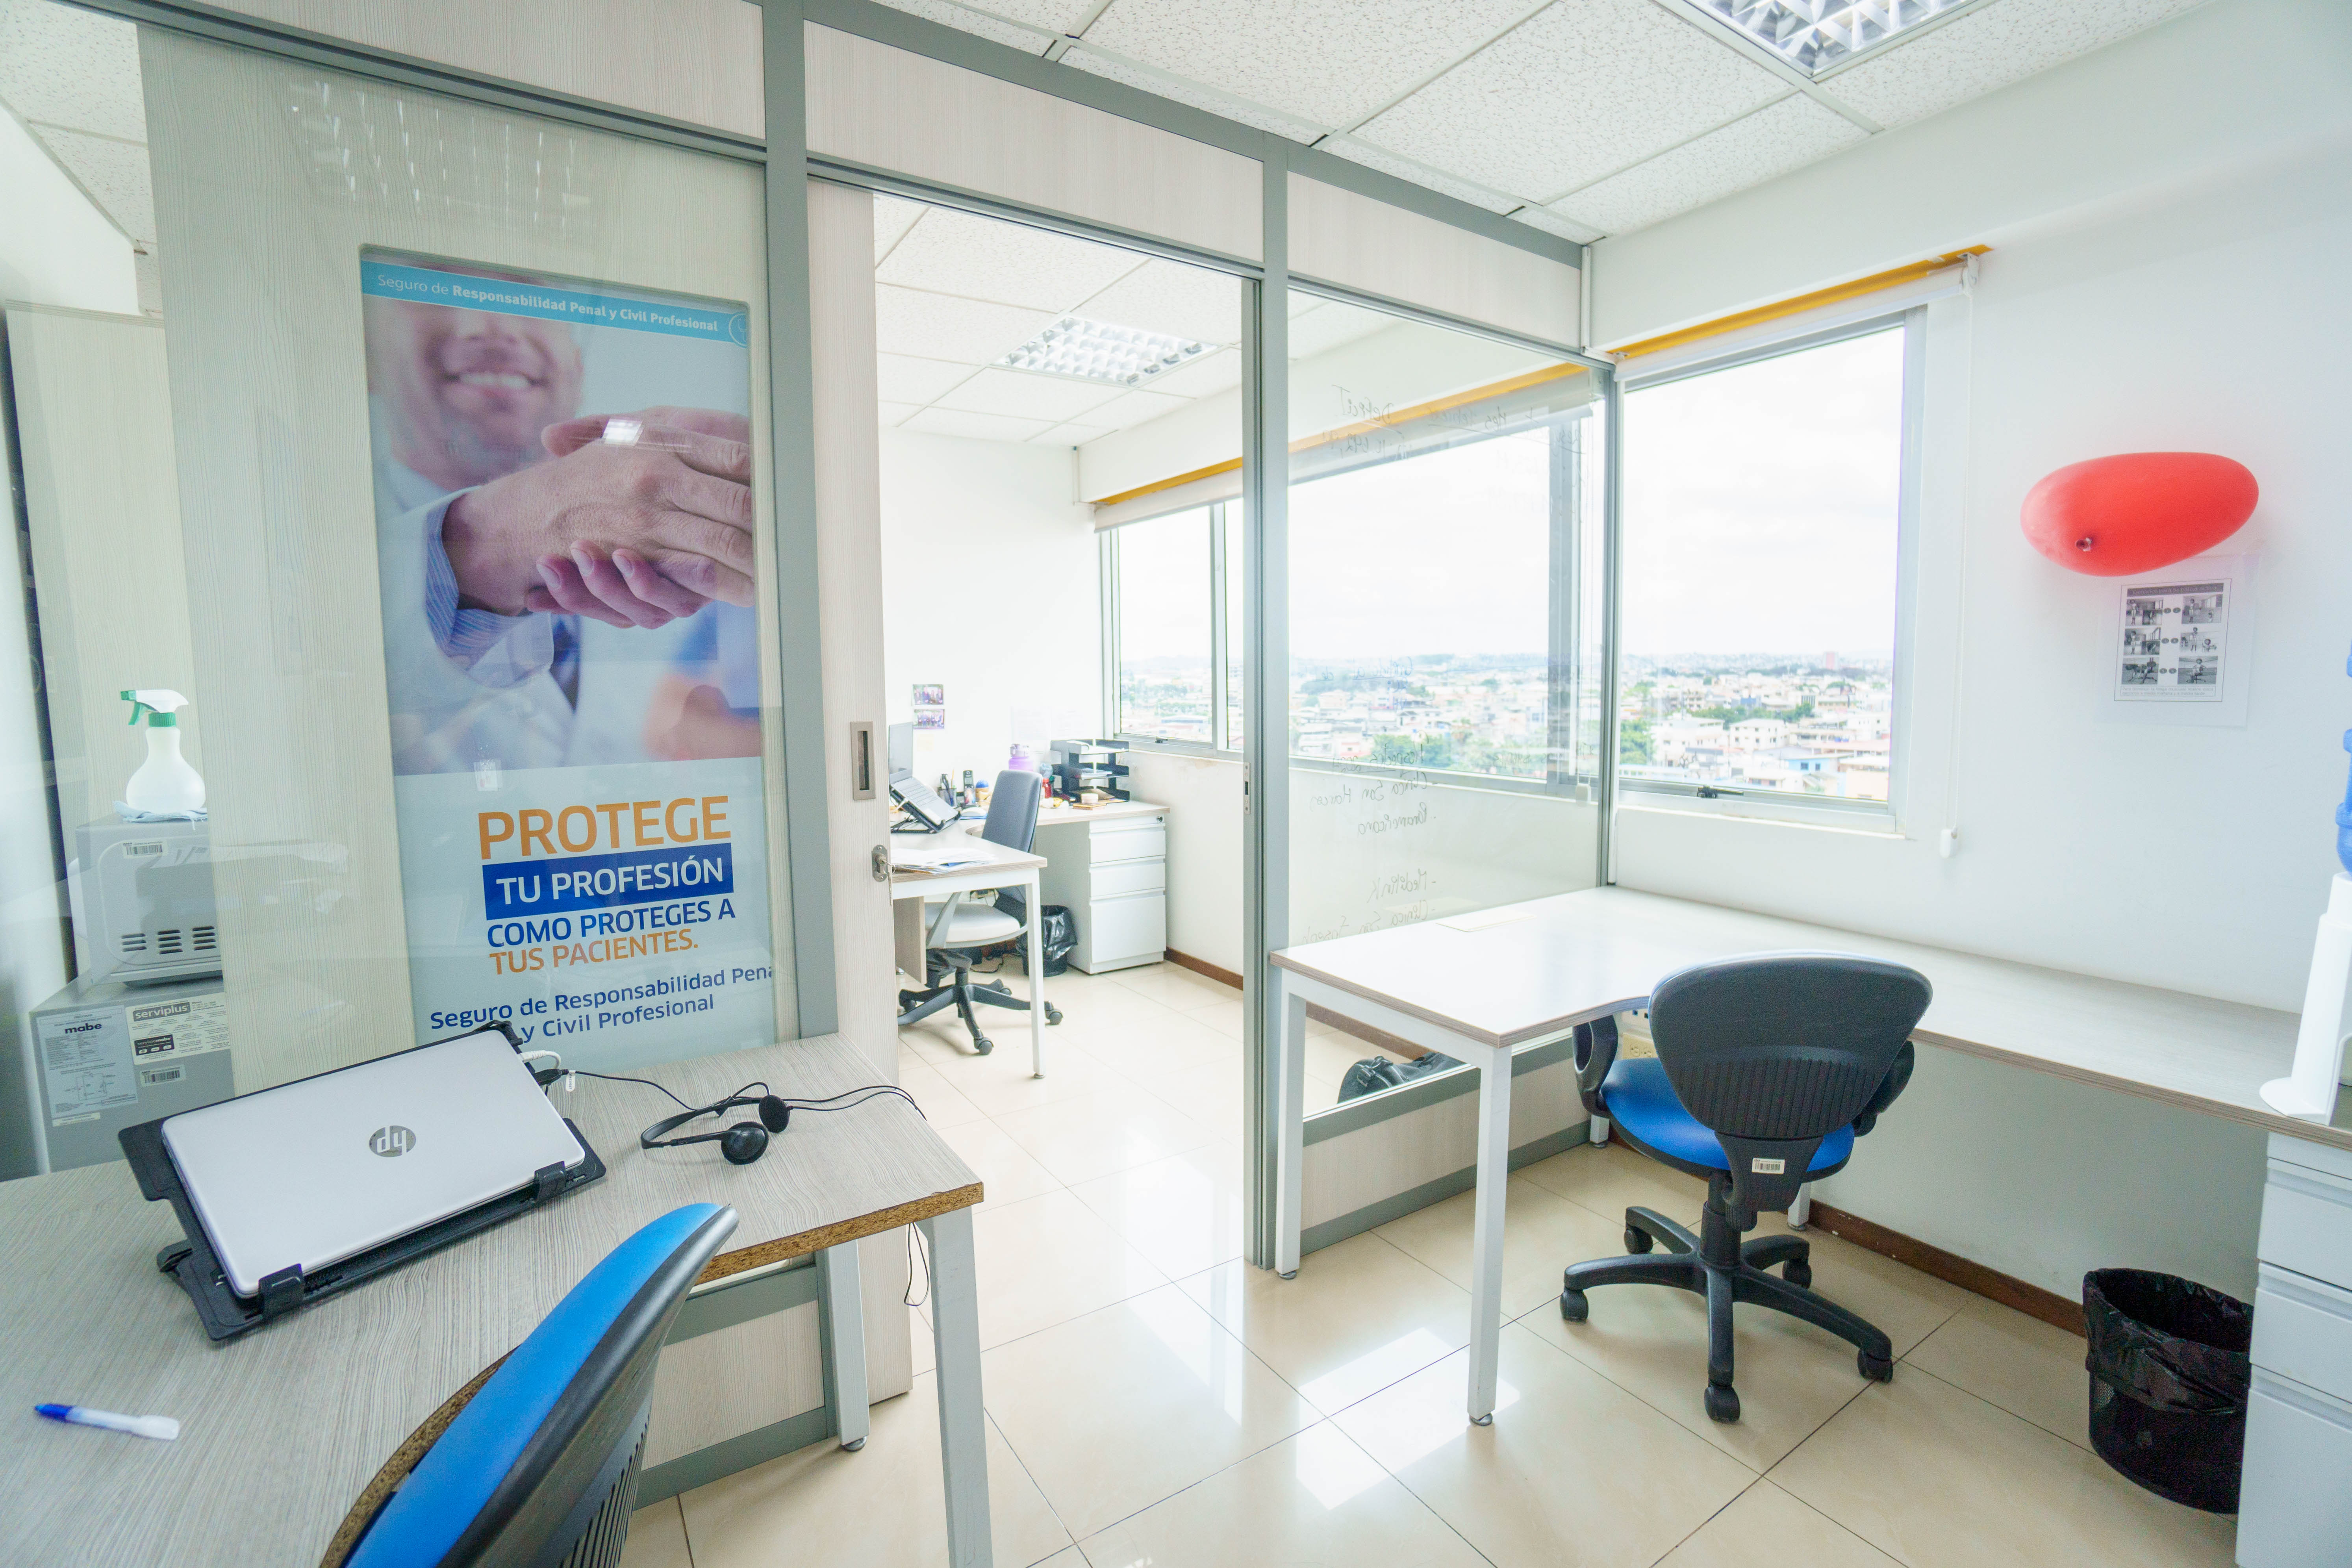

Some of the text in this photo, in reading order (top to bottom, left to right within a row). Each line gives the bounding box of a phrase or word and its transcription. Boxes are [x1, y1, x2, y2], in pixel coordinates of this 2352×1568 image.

[377, 274, 718, 332] Seguro de Responsabilidad Penal y Civil Profesional
[478, 795, 731, 860] PROTEGE
[496, 855, 723, 905] TU PROFESIÓN
[488, 898, 736, 948] COMO PROTEGES A
[489, 928, 699, 975] TUS PACIENTES.
[135, 1004, 188, 1019] serviplus
[430, 1005, 512, 1029] Seguro
[520, 998, 547, 1016] de
[555, 969, 725, 1011] Responsabilidad
[521, 993, 714, 1043] y Civil Profesional
[64, 1023, 102, 1034] mabe
